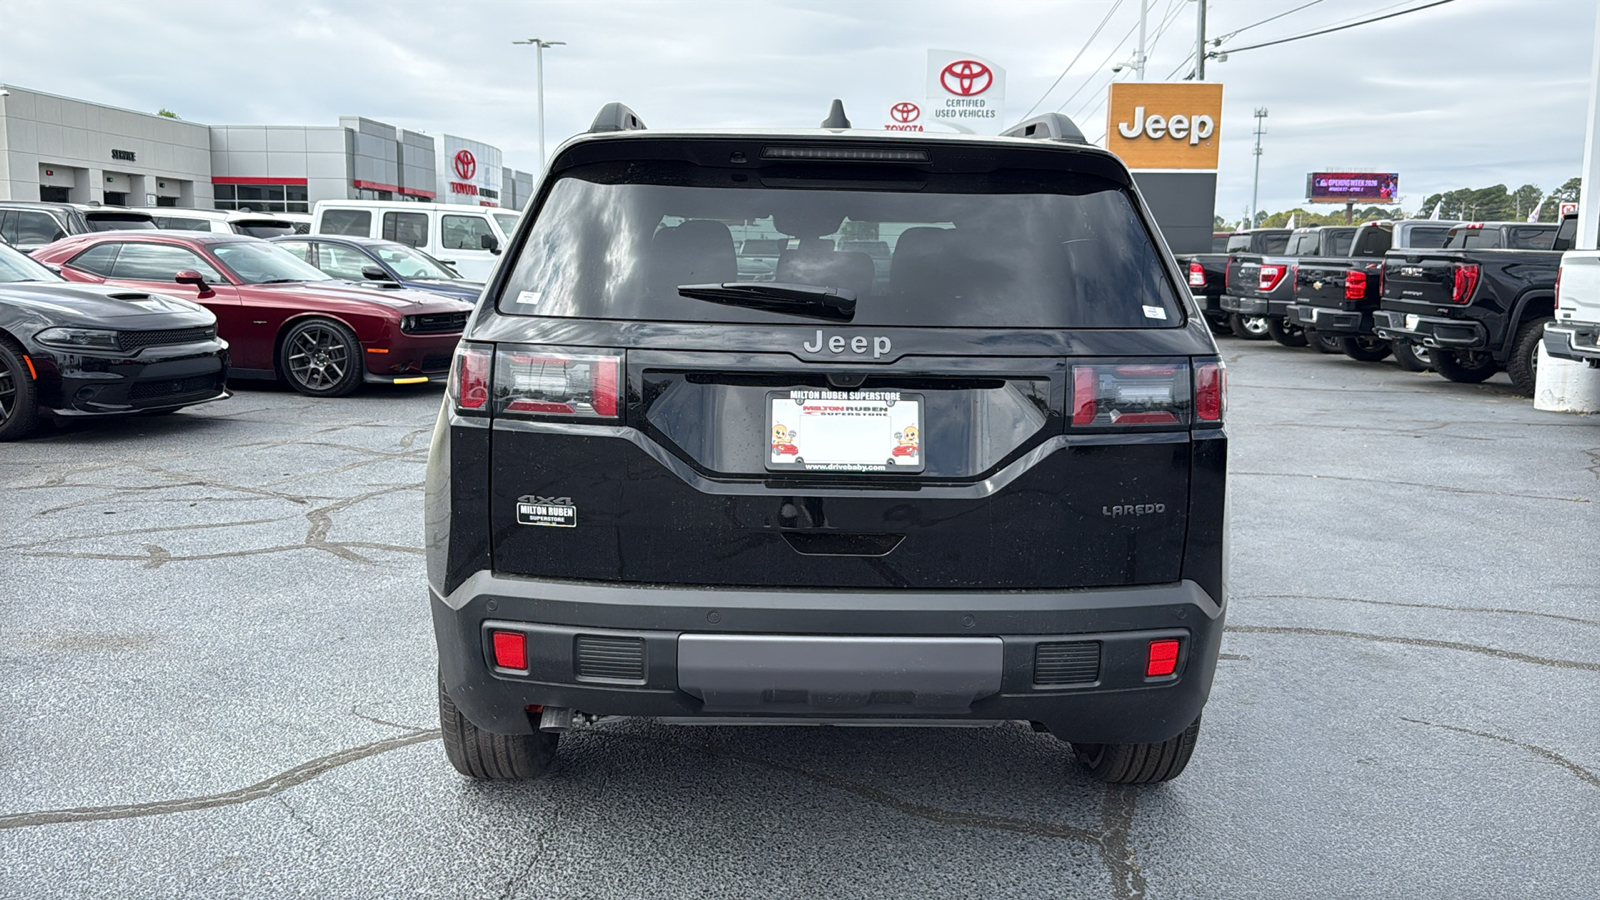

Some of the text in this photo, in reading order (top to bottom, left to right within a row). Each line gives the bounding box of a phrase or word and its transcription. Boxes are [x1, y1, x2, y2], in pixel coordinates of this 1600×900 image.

[946, 99, 986, 108] CERTIFIED
[935, 109, 996, 118] USED VEHICLES
[1118, 106, 1214, 146] Jeep
[450, 181, 478, 195] TOYOTA
[803, 330, 892, 359] Jeep
[790, 390, 901, 401] MILTON RUBEN SUPERSTORE
[805, 463, 886, 472] www.drivebaby.com
[520, 505, 574, 517] MILTON RUBEN
[1102, 503, 1166, 516] LAREDO
